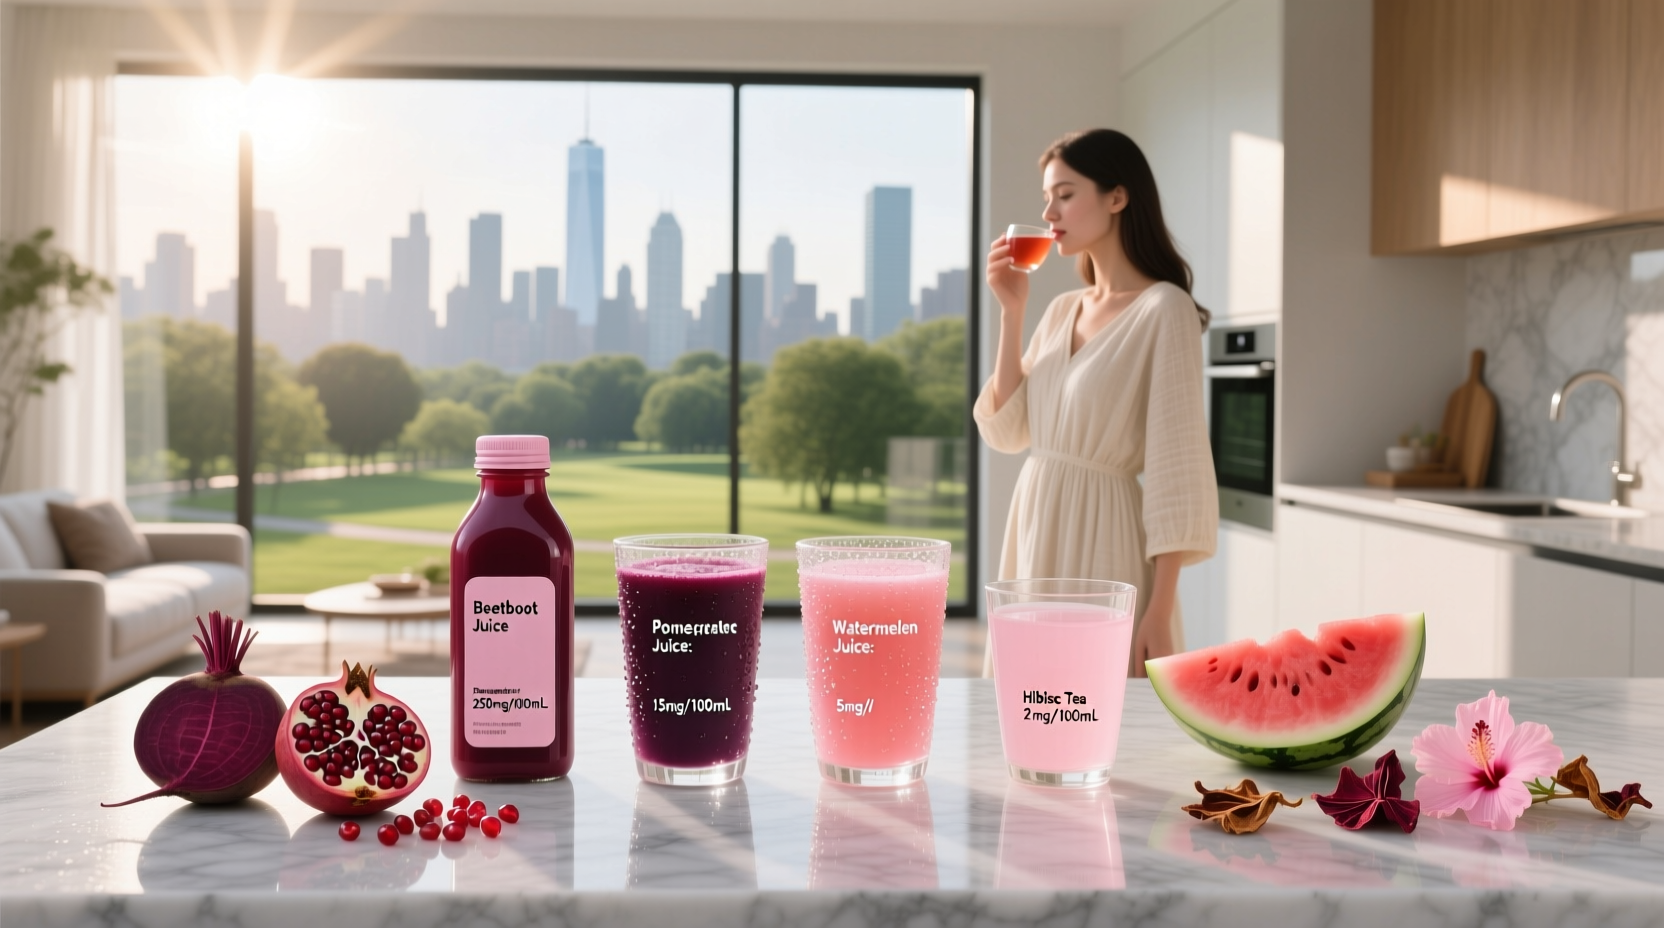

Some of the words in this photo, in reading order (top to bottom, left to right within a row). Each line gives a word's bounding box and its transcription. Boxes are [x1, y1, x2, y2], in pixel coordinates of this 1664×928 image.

[473, 600, 538, 615] Beetboot
[473, 618, 509, 632] Juice
[832, 619, 918, 636] Watermelen
[652, 638, 693, 653] Juice:
[833, 637, 875, 654] Juice:
[1063, 691, 1087, 705] Tea
[653, 697, 732, 715] 15mg/100mL
